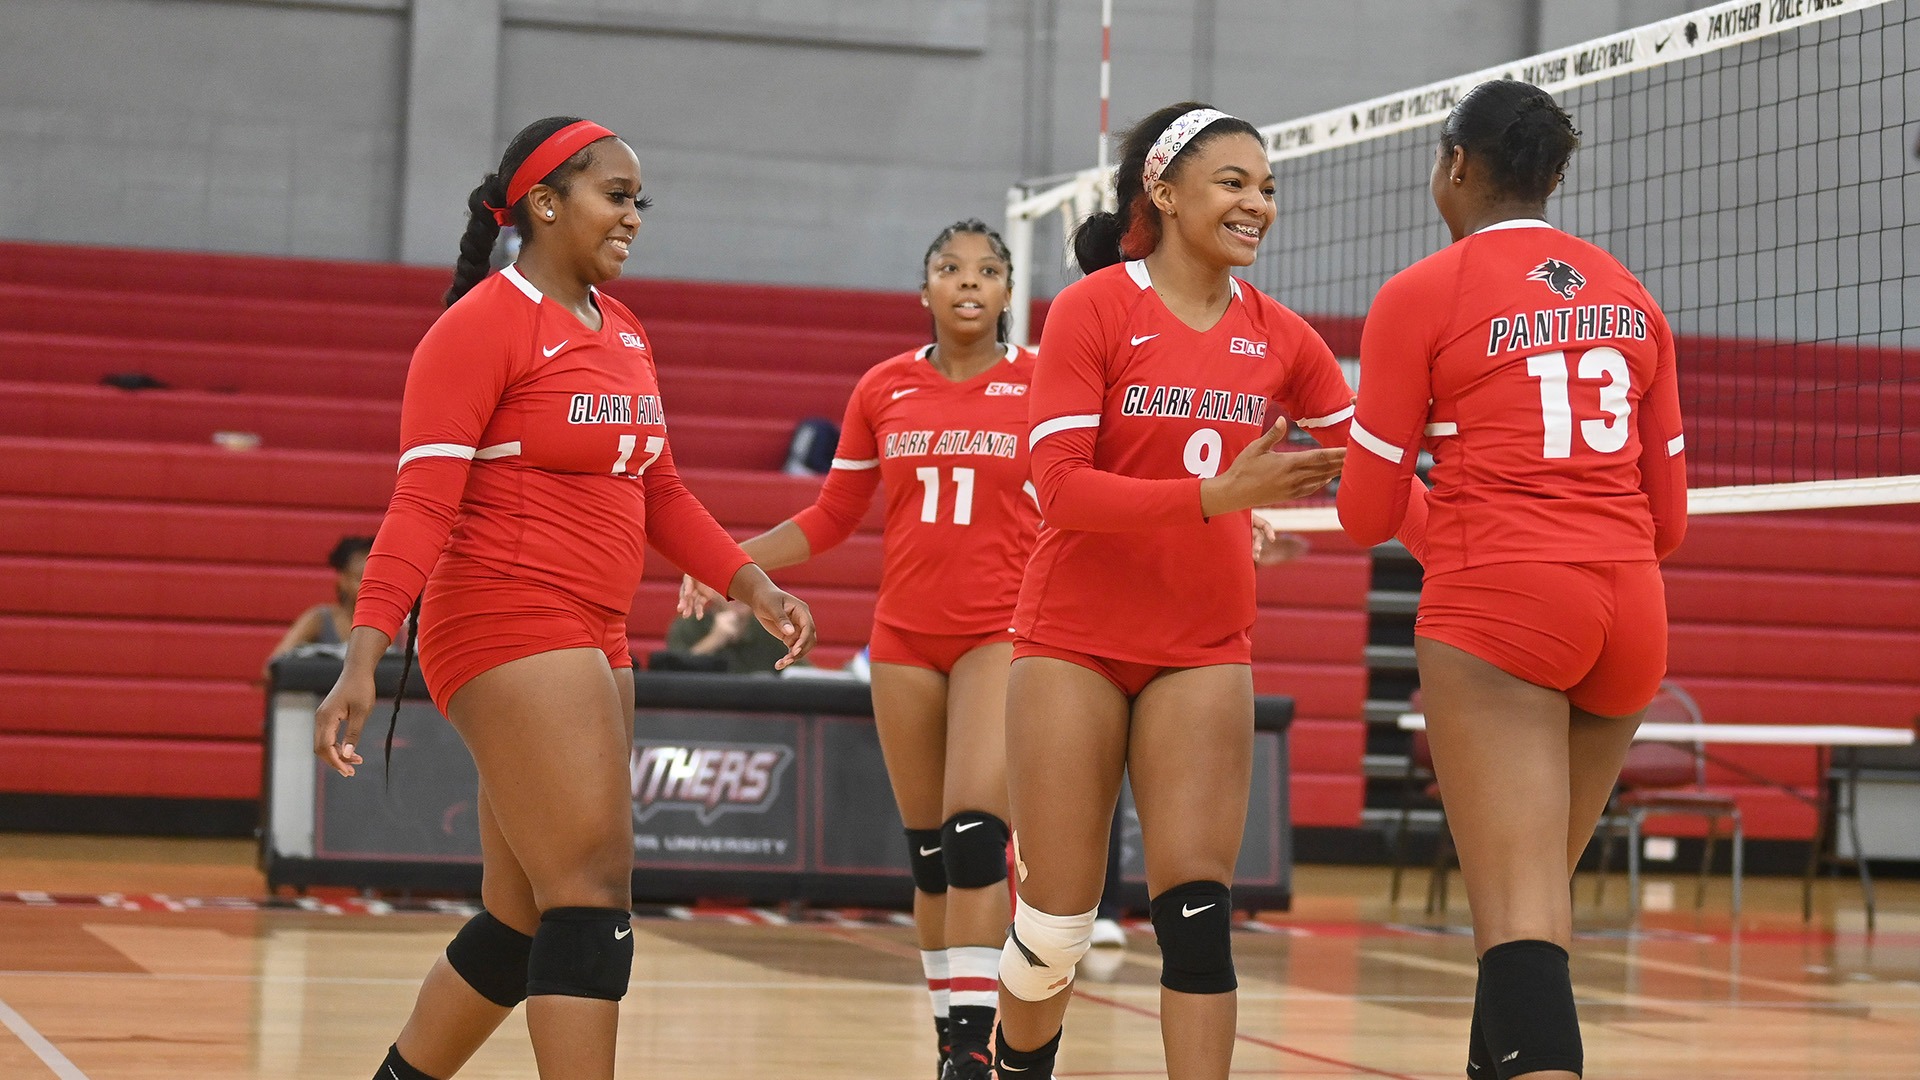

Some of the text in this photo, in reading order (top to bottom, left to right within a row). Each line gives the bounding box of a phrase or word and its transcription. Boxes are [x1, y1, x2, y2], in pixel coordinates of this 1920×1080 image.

[1769, 0, 1843, 24] VOLLEY
[1230, 337, 1267, 358] SIAC
[1487, 304, 1647, 356] PANTHERS
[985, 382, 1027, 396] SIAC
[1121, 384, 1196, 418] CLARK
[1526, 347, 1631, 458] 13
[568, 394, 632, 425] CLARK
[611, 435, 665, 479] 17
[885, 430, 1018, 459] CLARK ATLANTA
[1183, 428, 1222, 479] 9
[916, 467, 975, 526] 11
[630, 747, 778, 806] NTHERS
